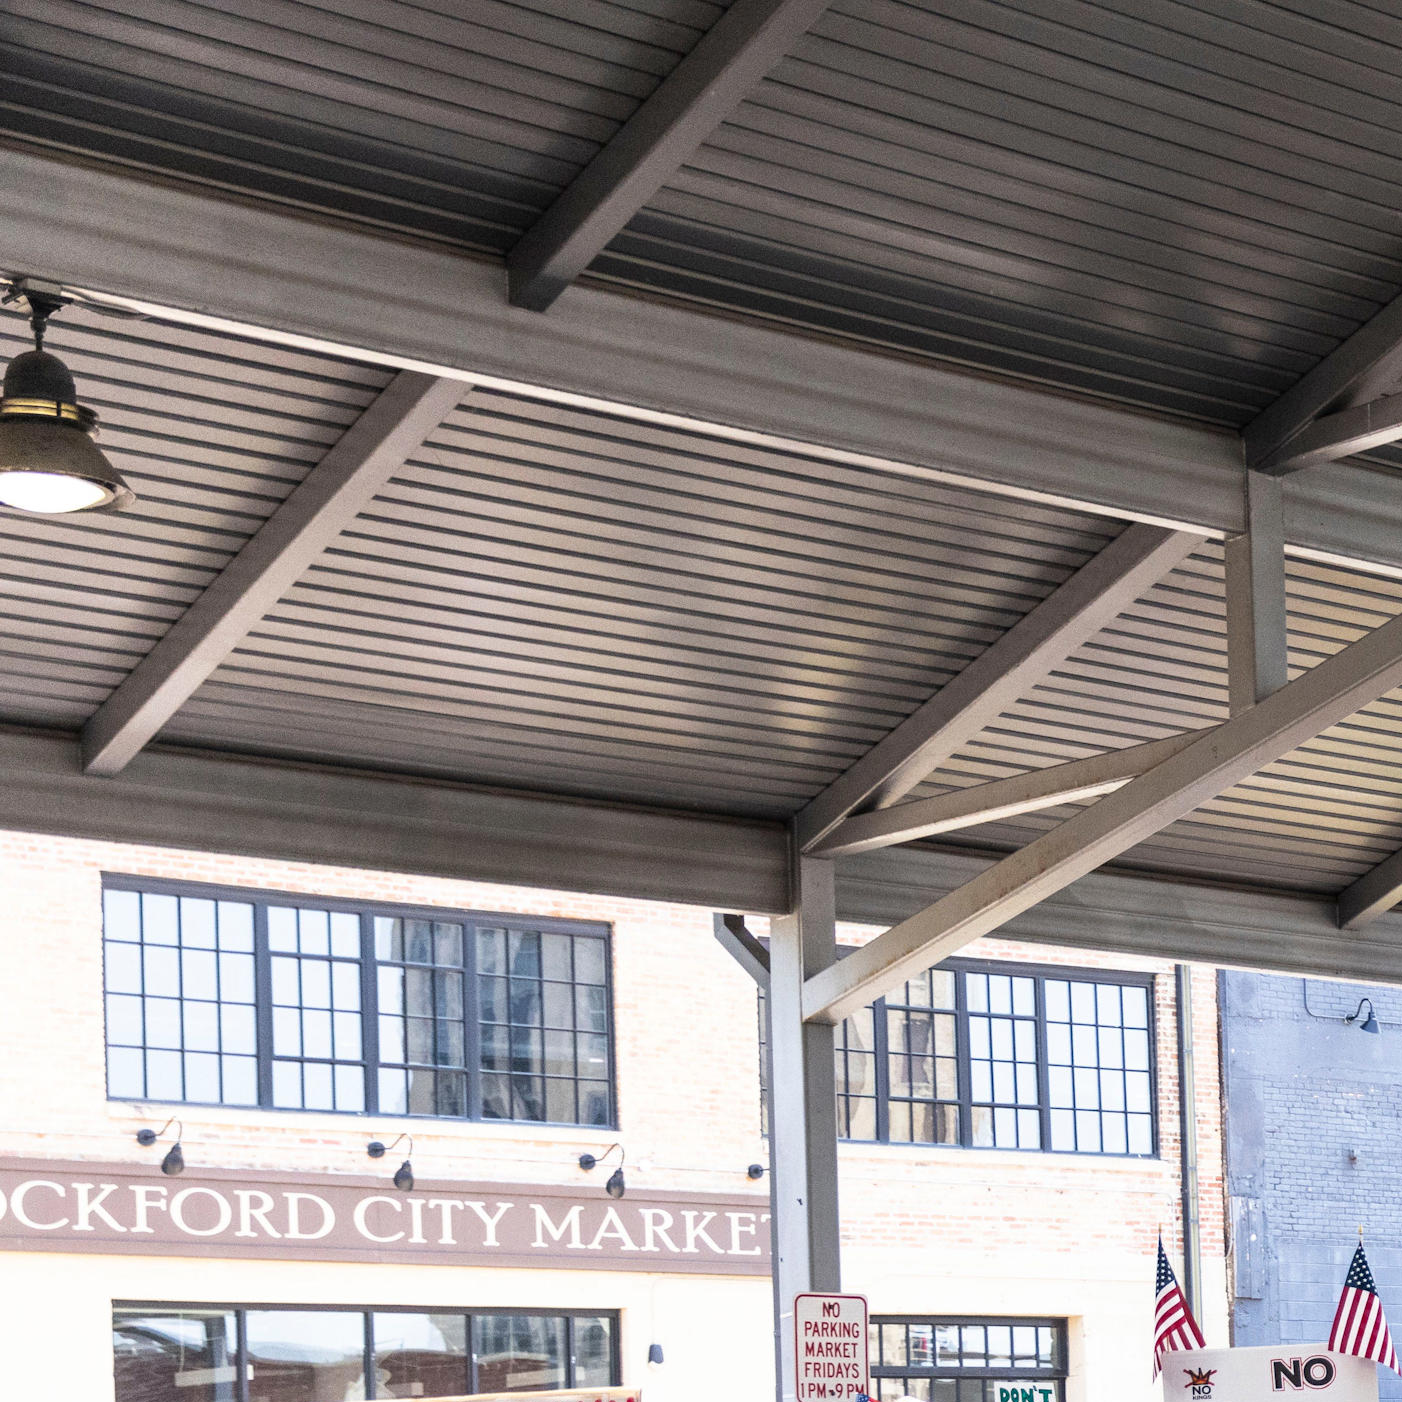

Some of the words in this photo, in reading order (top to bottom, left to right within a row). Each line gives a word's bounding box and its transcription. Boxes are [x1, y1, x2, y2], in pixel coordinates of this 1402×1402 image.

[0, 1180, 336, 1240] CKFORD
[353, 1196, 514, 1247] CITY
[530, 1204, 770, 1256] MARKE
[822, 1302, 841, 1318] NO
[804, 1321, 860, 1339] PARKING
[804, 1342, 858, 1358] MARKET
[804, 1362, 860, 1379] FRIDAYS
[1270, 1355, 1337, 1392] NO
[1191, 1385, 1211, 1396] NO
